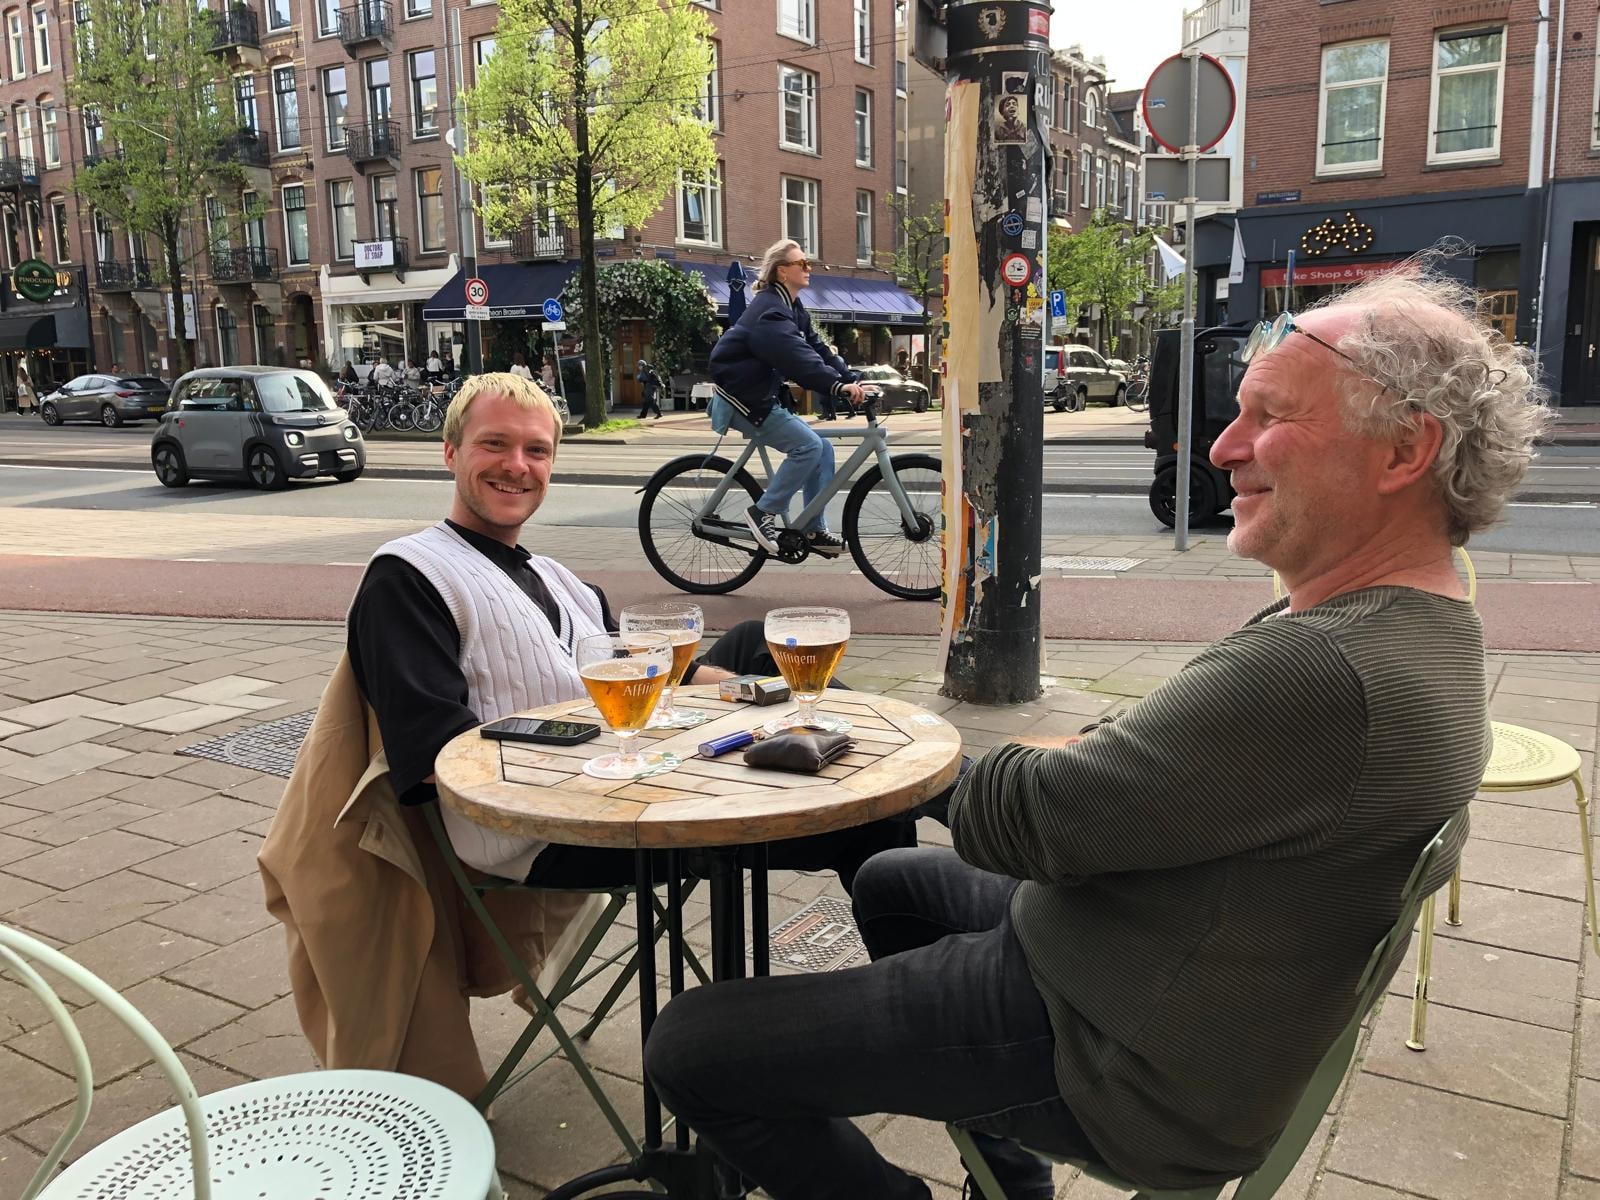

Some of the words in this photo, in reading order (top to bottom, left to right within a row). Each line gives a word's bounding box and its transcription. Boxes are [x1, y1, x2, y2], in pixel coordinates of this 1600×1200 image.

[18, 276, 55, 284] PINOCCHIO
[1310, 271, 1342, 280] Shop
[1344, 269, 1354, 277] &
[470, 286, 484, 297] 30
[1053, 293, 1061, 306] P
[503, 308, 526, 316] Brasserie
